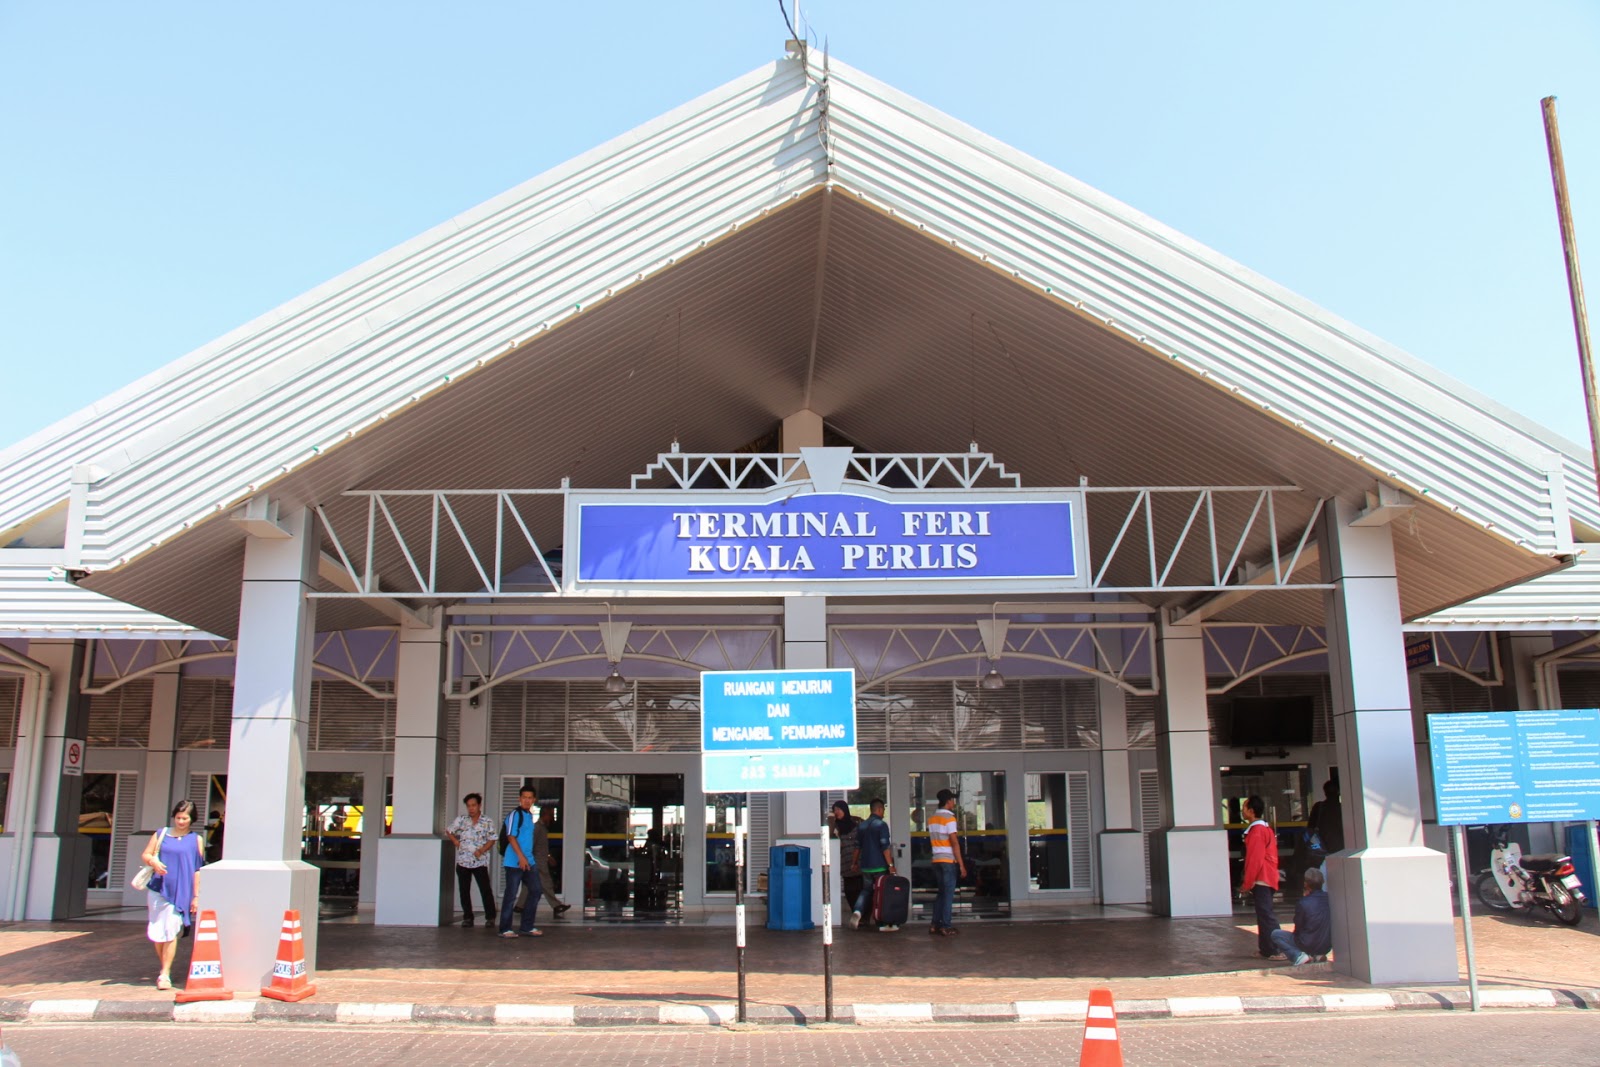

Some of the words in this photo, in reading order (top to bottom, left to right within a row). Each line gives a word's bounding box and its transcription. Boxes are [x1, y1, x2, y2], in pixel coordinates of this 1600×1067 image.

[673, 511, 877, 538] TERMINAL
[902, 511, 991, 537] FERI
[688, 545, 815, 572] KUALA
[842, 543, 979, 570] PERLIS
[724, 681, 775, 696] RUANGAN
[782, 680, 832, 695] MENURUN
[767, 703, 790, 718] DAN
[712, 726, 774, 742] MENGAMBIL
[781, 724, 846, 740] PENUMPANG
[192, 964, 220, 975] POLIS
[275, 962, 292, 976] POLIS
